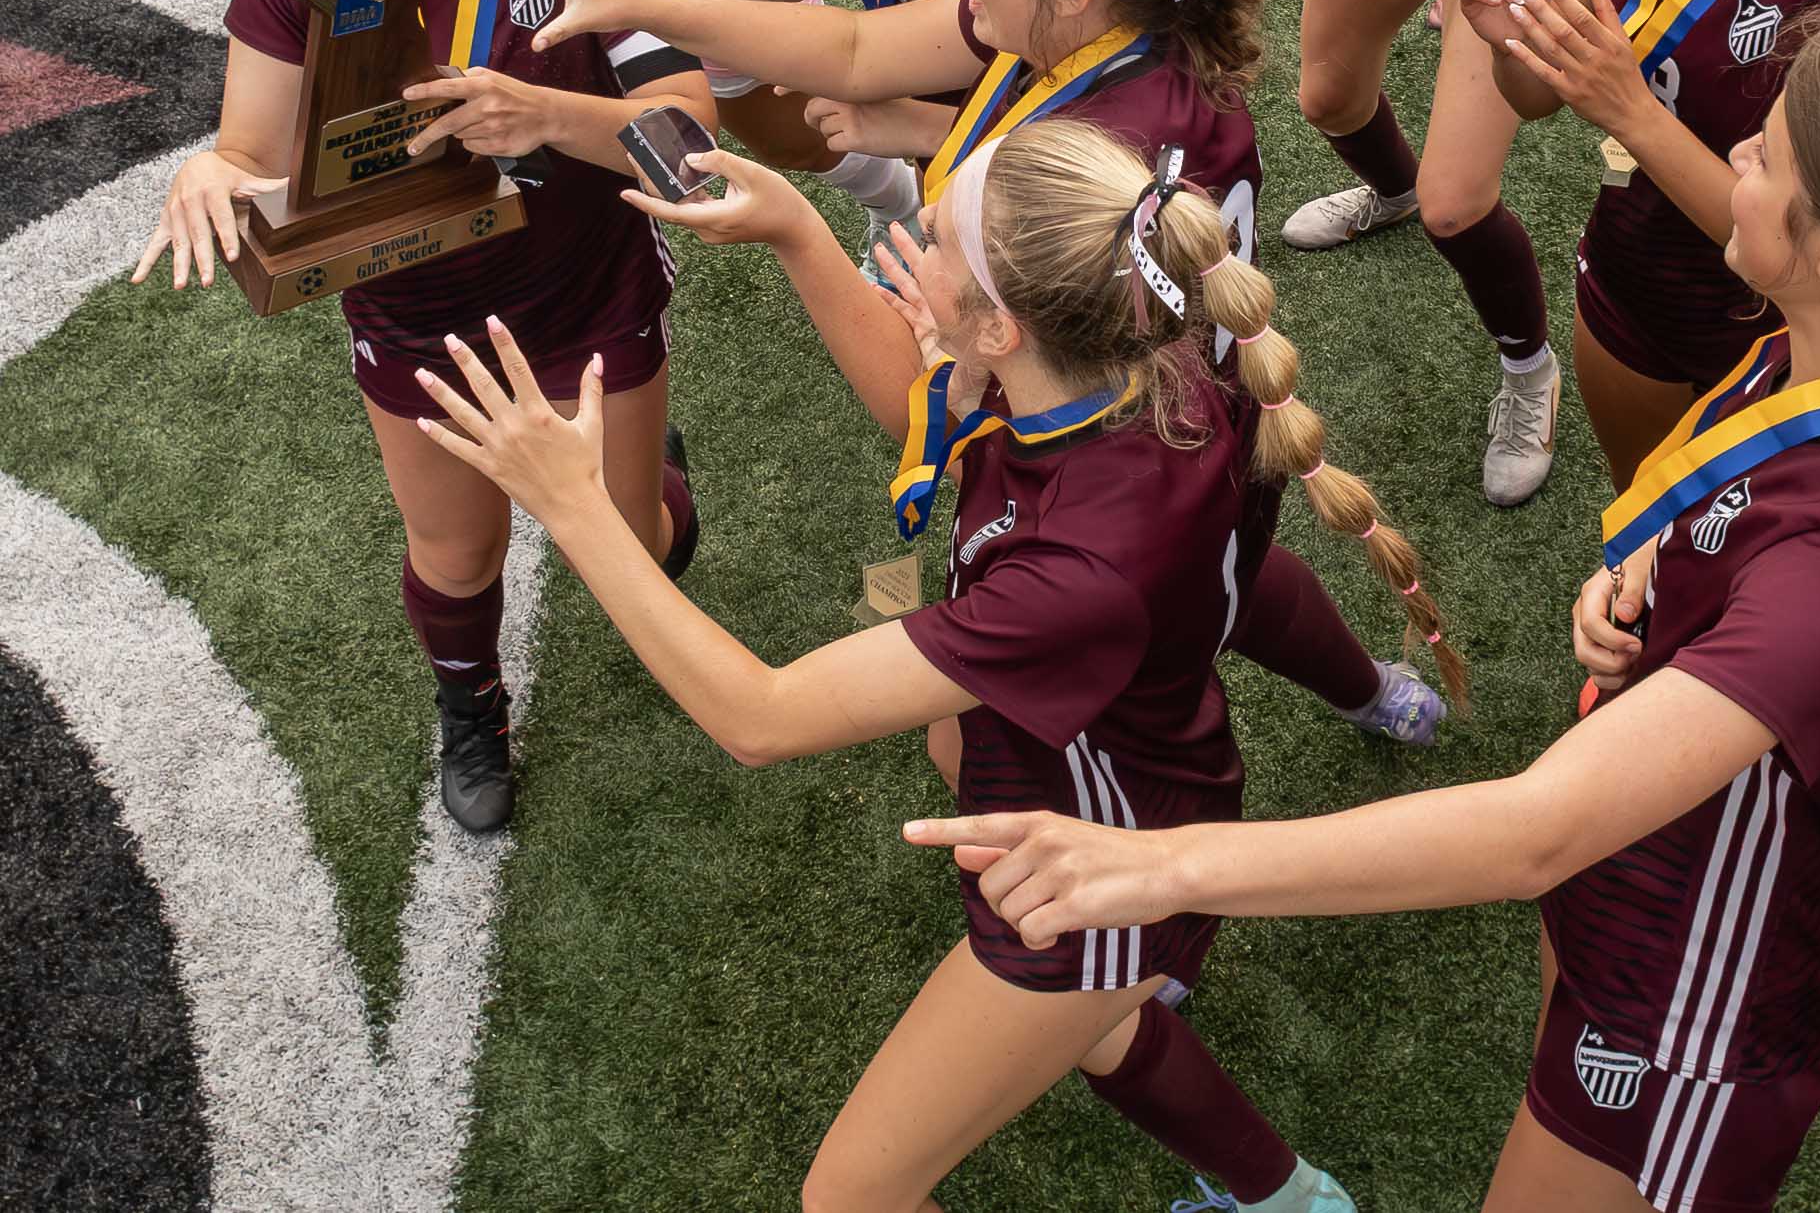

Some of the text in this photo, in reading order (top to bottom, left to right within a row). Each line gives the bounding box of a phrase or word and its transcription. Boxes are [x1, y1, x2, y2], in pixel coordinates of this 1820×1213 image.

[326, 117, 404, 151] DELAWARE
[371, 232, 419, 259] Division
[398, 239, 443, 265] Soccer
[870, 578, 910, 608] CHAMPION
